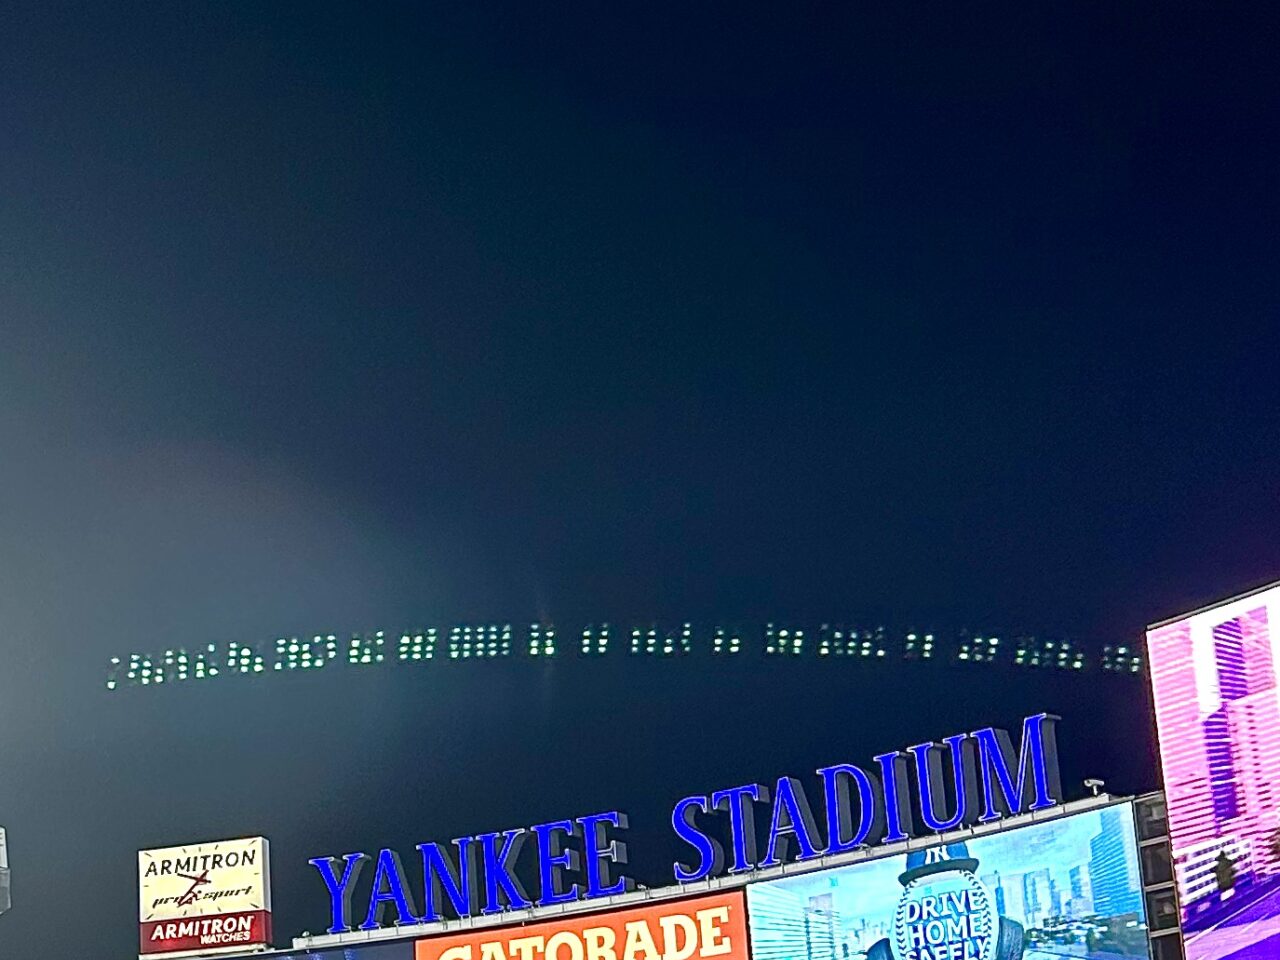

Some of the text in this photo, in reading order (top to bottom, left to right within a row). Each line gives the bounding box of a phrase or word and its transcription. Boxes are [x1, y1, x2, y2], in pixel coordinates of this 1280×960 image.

[309, 713, 1060, 932] YANKEE STADIUM
[144, 849, 256, 877] ARMITRON
[905, 890, 983, 923] DRIVE
[151, 915, 253, 941] ARMITRON
[200, 930, 251, 945] WATCHES
[908, 914, 982, 948] HOME
